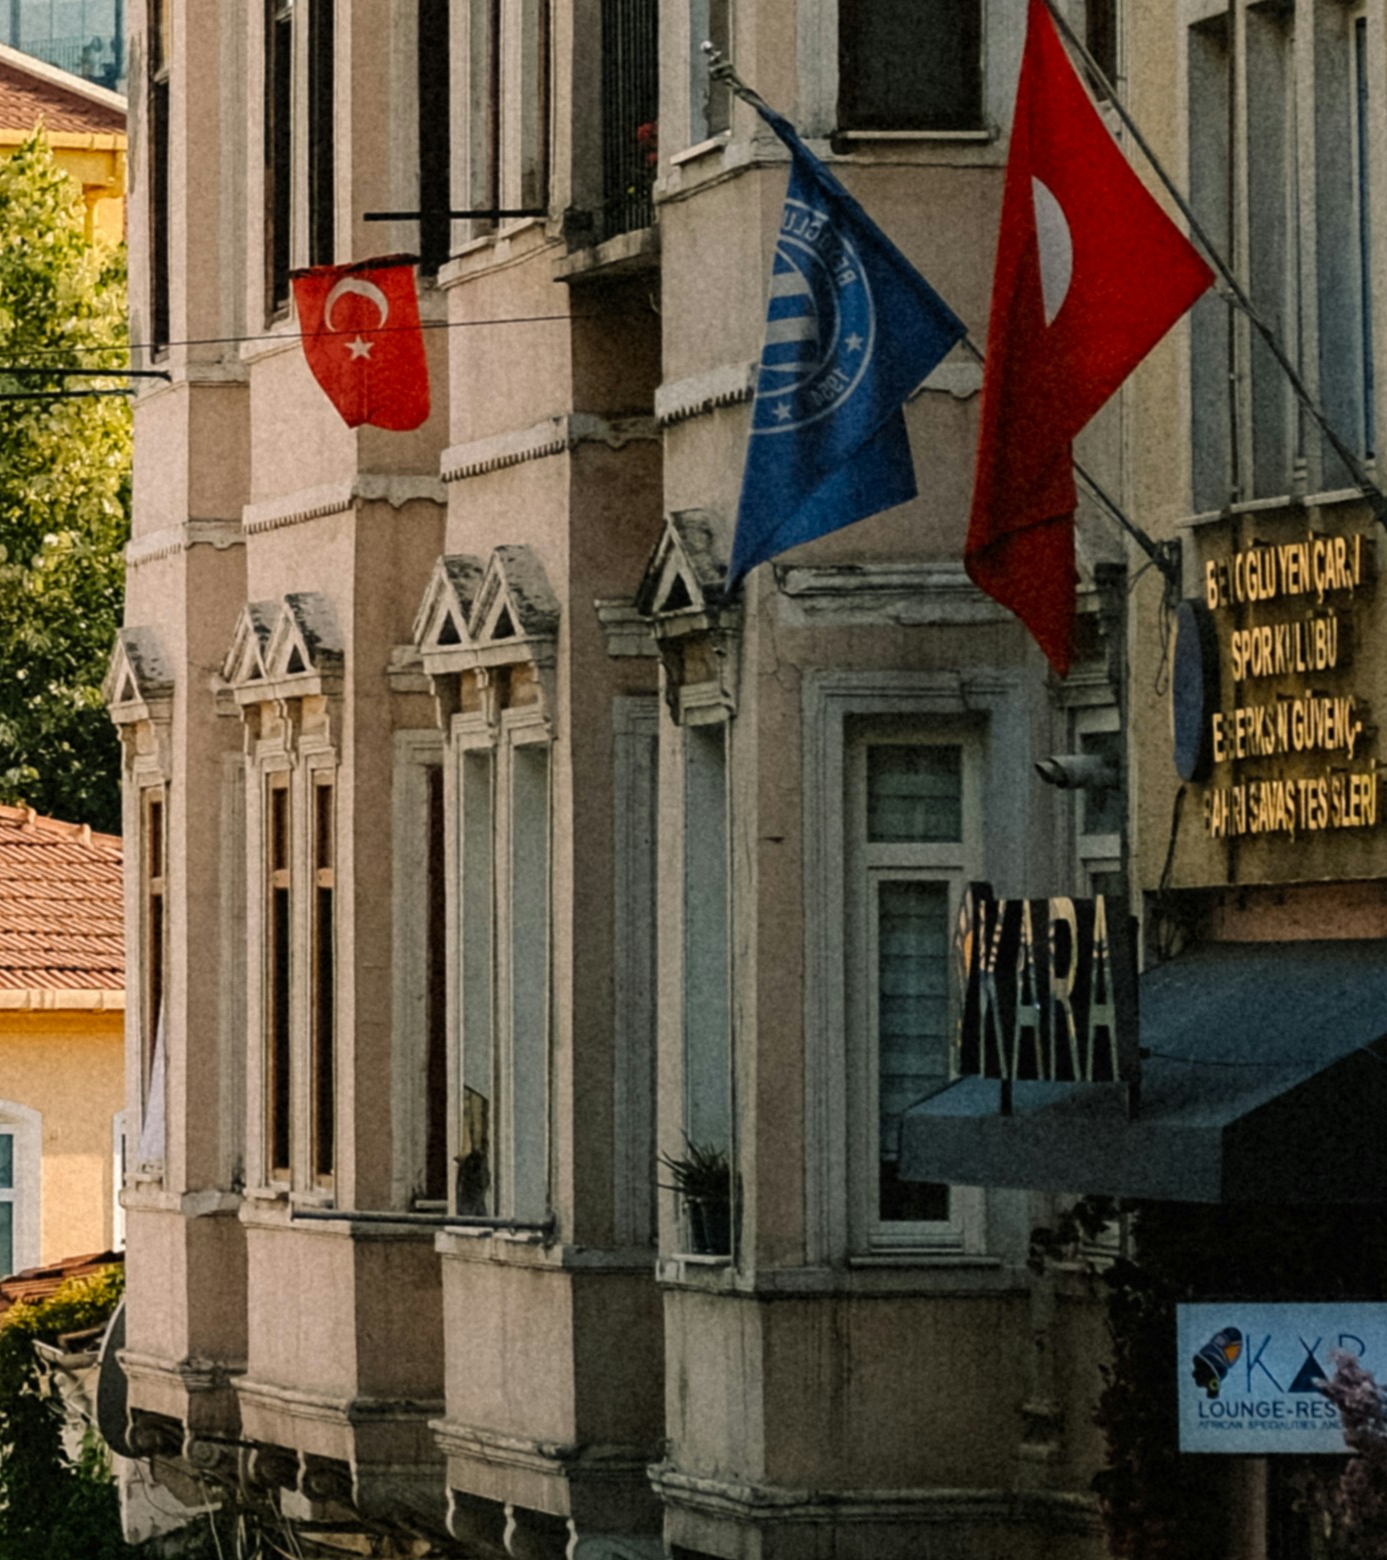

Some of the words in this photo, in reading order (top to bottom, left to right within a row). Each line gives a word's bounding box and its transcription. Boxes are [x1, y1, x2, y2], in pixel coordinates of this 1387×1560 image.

[1231, 625, 1273, 681] SPOR
[1274, 607, 1338, 675] KULÜBÜ
[978, 893, 1121, 1082] KARA
